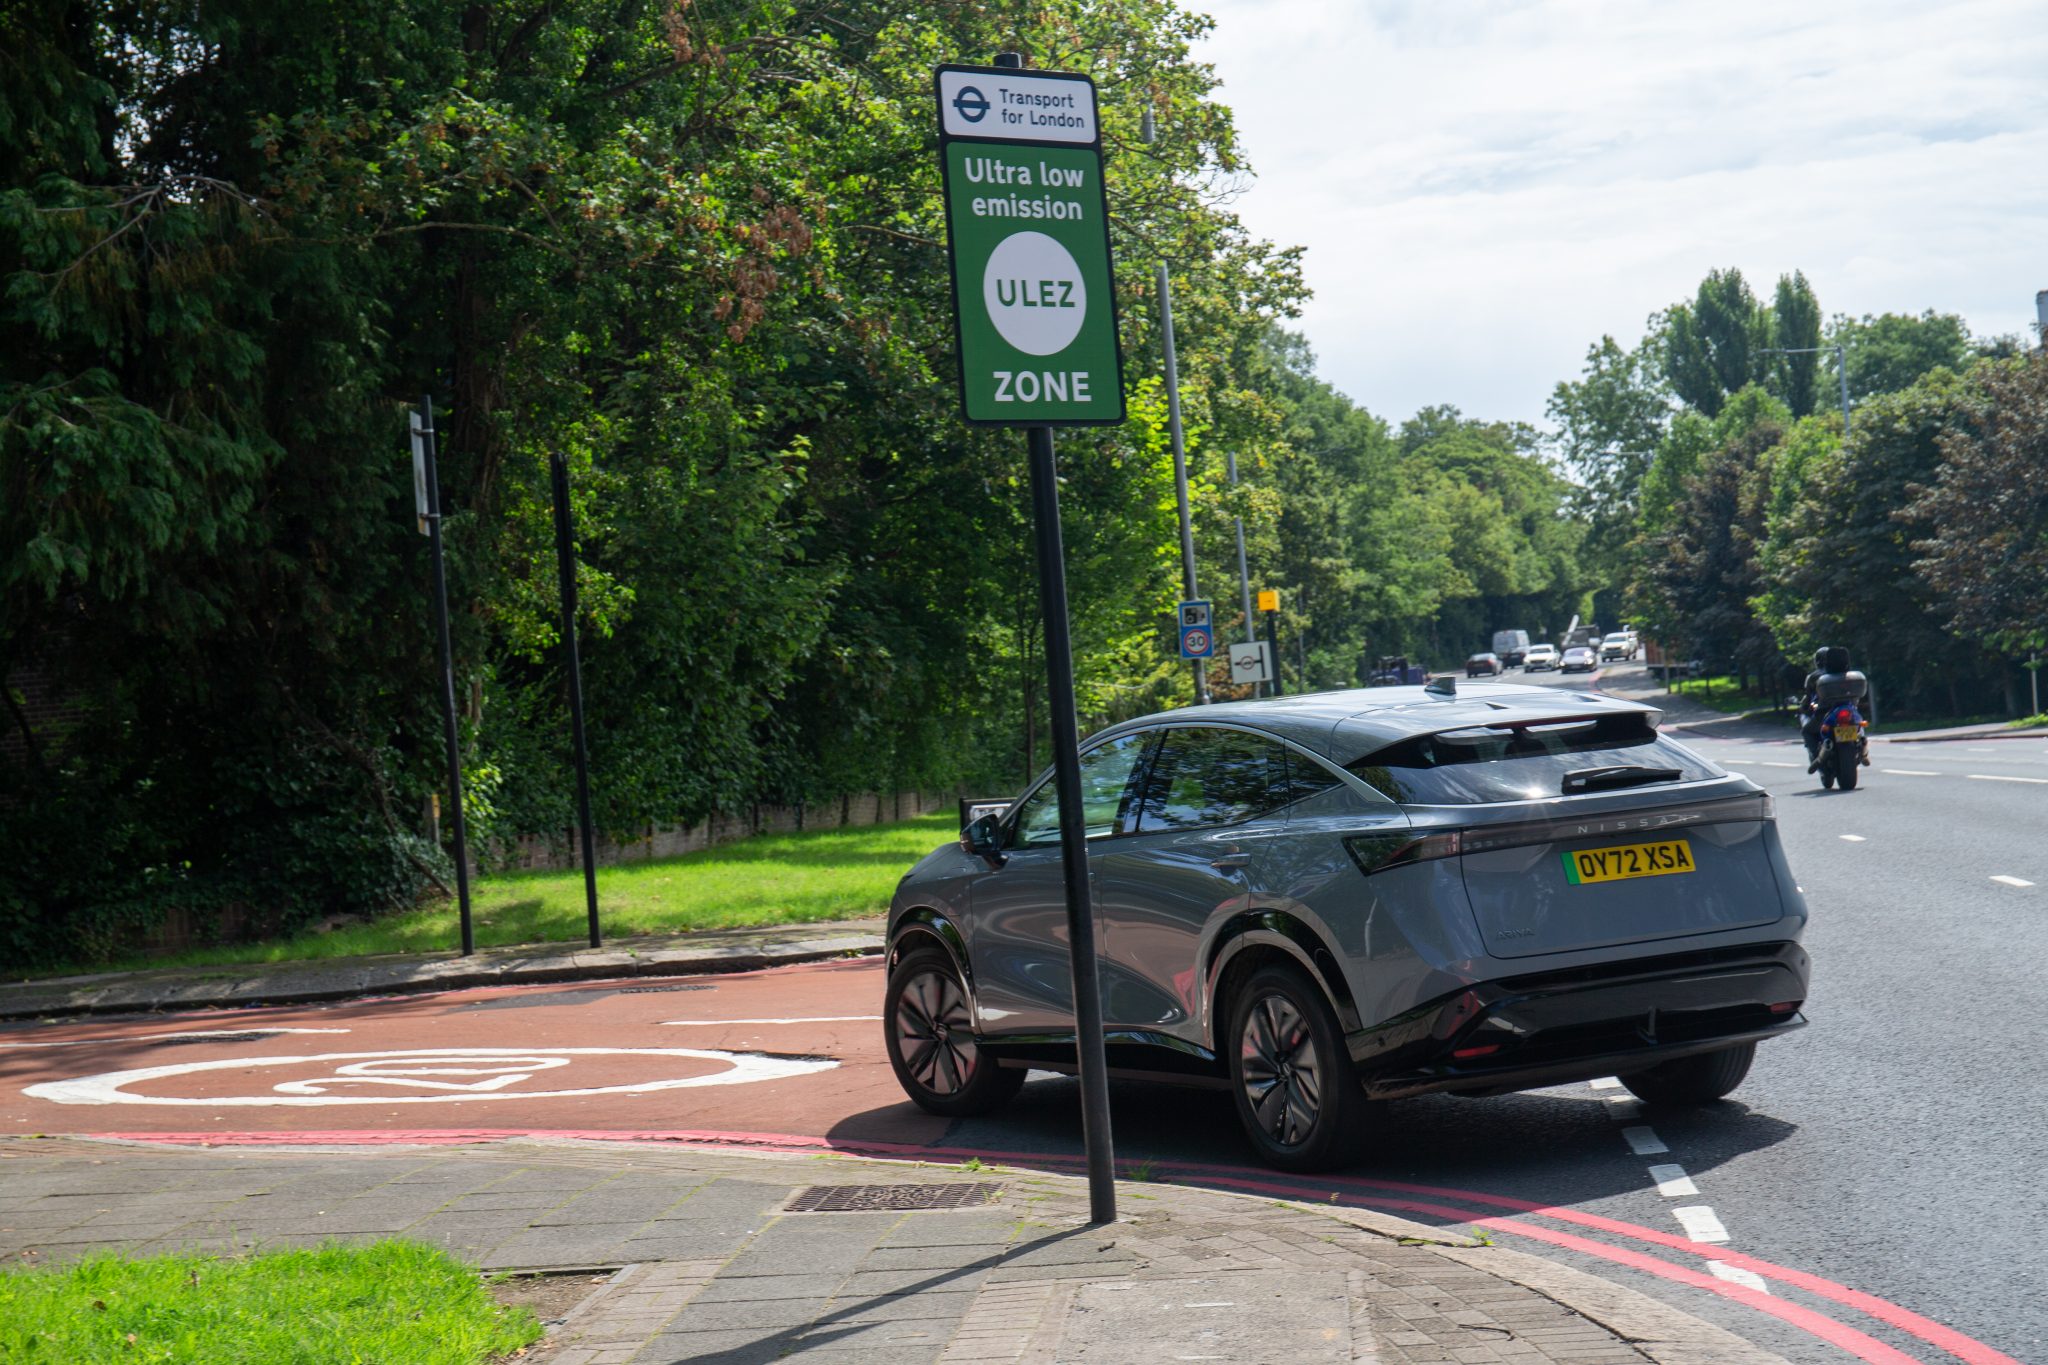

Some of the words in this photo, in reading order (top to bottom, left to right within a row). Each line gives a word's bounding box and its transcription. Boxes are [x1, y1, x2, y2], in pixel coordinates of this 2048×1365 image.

[998, 88, 1074, 108] Transport
[1002, 107, 1023, 124] for
[1030, 108, 1085, 128] London
[965, 157, 1032, 185] Ultra
[1040, 161, 1084, 187] low
[972, 193, 1083, 220] emission
[996, 279, 1076, 307] ULEZ
[993, 371, 1092, 402] ZONE
[1188, 636, 1204, 647] 30
[1577, 815, 1690, 834] NISSAN
[1579, 849, 1642, 878] OY72
[1643, 844, 1690, 871] XSA
